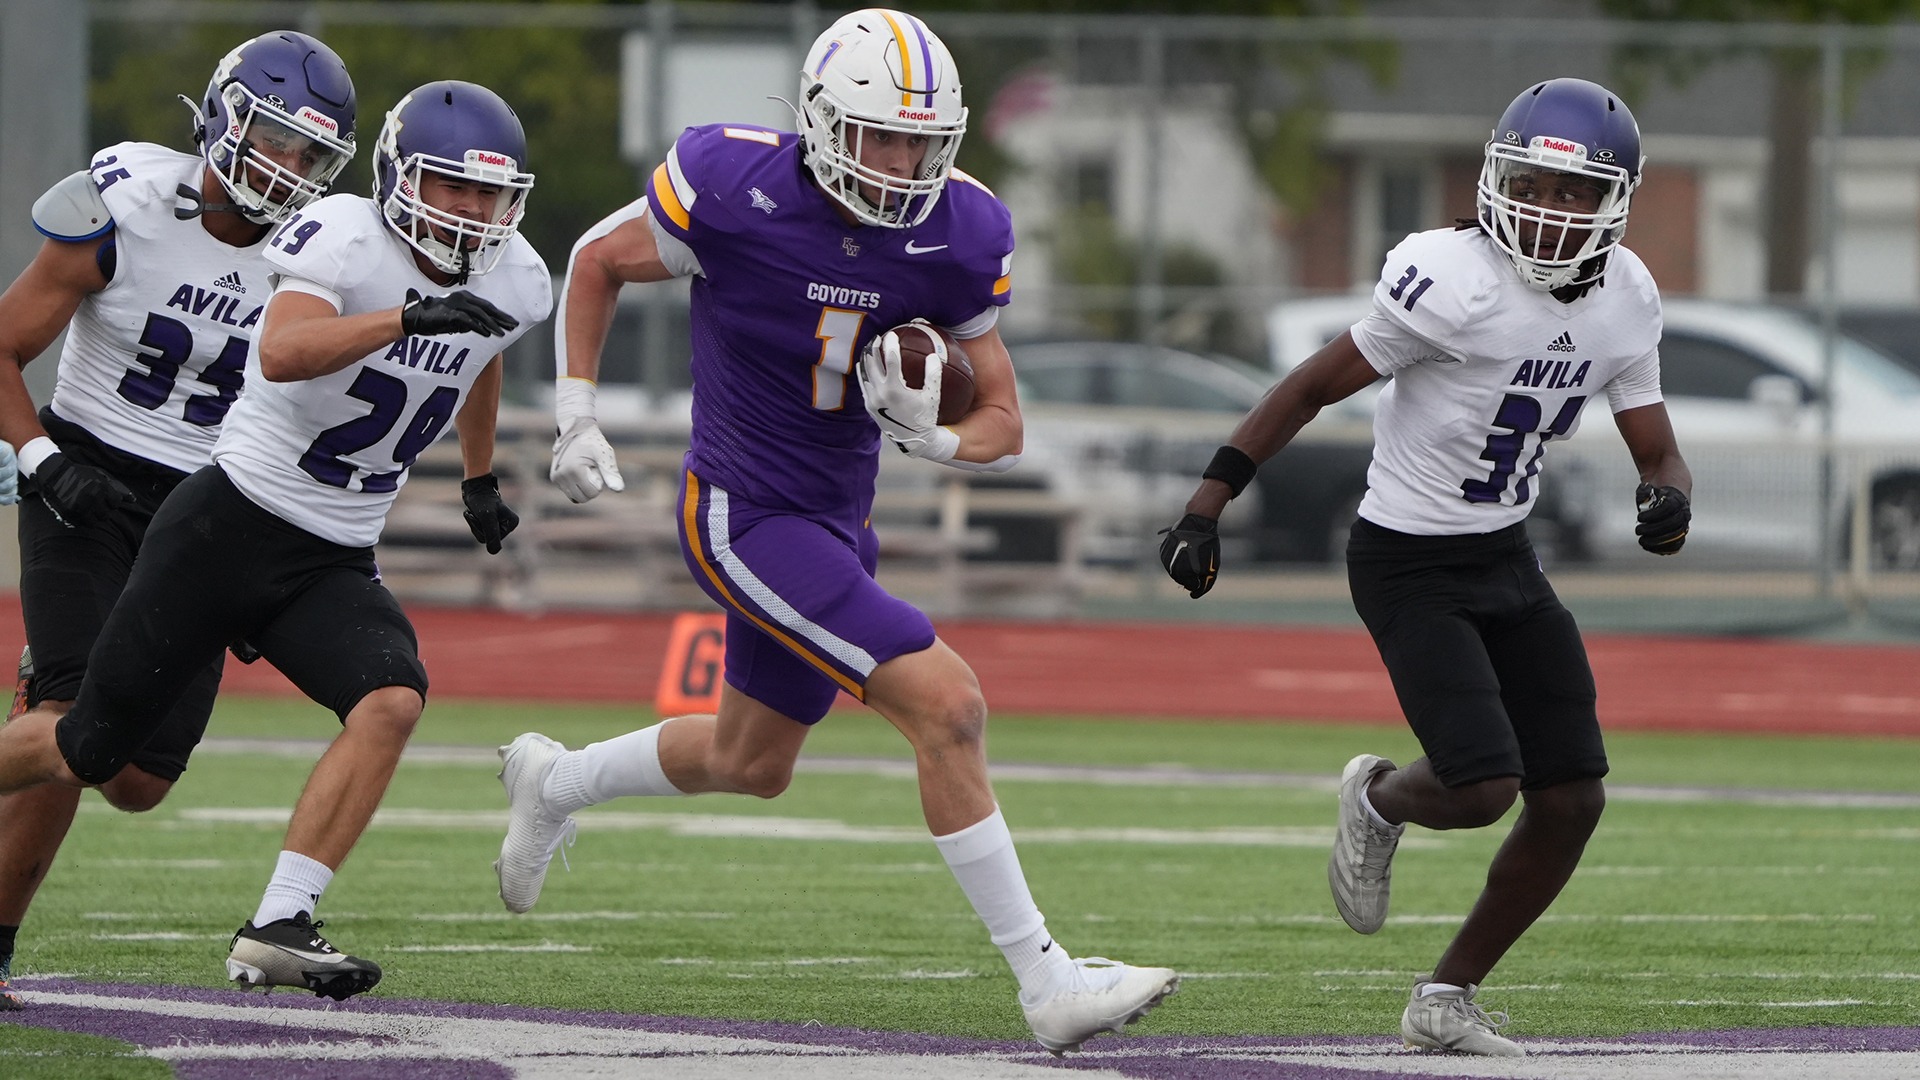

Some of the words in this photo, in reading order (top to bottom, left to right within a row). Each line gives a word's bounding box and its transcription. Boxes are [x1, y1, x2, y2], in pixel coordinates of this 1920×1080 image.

[814, 40, 843, 80] 1
[303, 110, 336, 131] Riddell
[898, 109, 936, 121] Riddell
[478, 153, 506, 166] Riddell
[1543, 138, 1576, 153] Riddell
[213, 279, 247, 294] adidas
[806, 282, 881, 309] COYOTES
[1389, 264, 1434, 312] 31
[384, 335, 471, 376] AVILA
[811, 306, 868, 412] 1
[1547, 343, 1576, 353] adidas
[1510, 359, 1592, 389] AVILA
[297, 365, 460, 494] 29
[1460, 393, 1588, 506] 31
[682, 629, 723, 697] G
